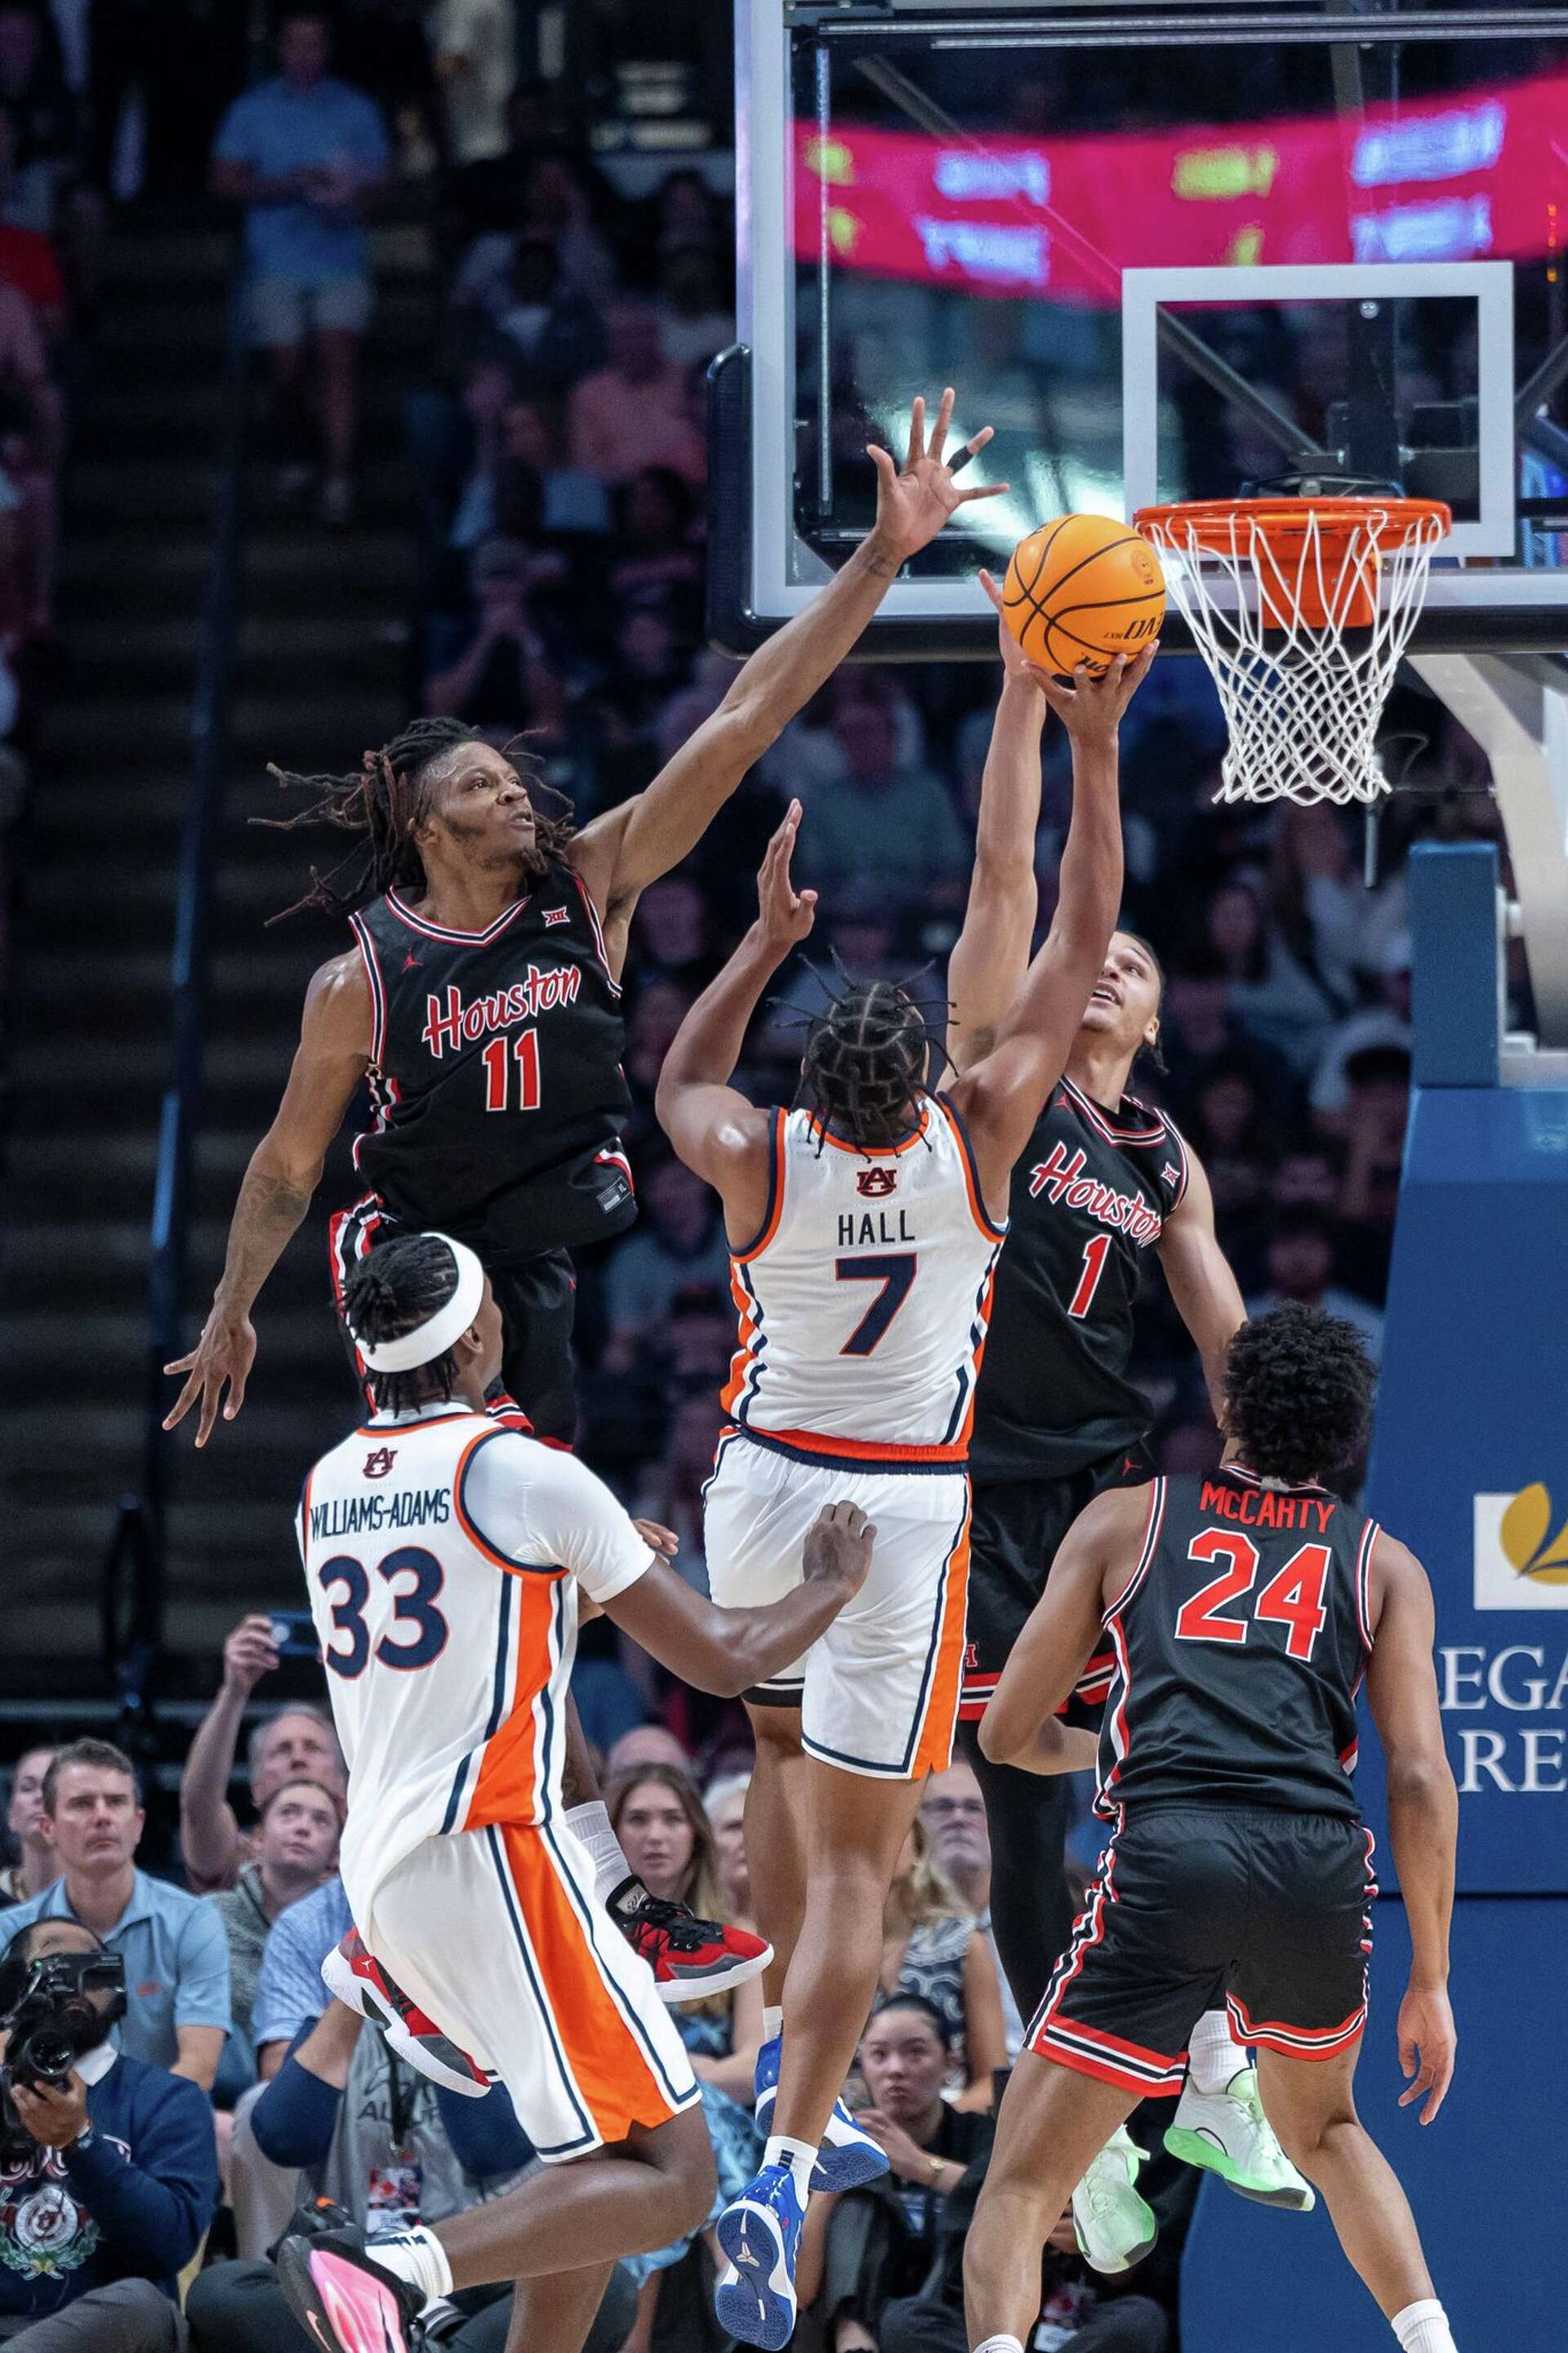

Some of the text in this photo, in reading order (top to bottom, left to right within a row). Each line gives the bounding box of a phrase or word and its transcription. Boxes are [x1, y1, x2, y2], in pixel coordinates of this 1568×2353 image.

[422, 963, 581, 1059] Houston
[482, 1027, 541, 1112] 11
[838, 1210, 915, 1246] HALL
[1029, 1140, 1163, 1249] Houston
[835, 1252, 918, 1357] 7
[1067, 1233, 1111, 1319] 1
[310, 1488, 451, 1542] WILLIAMS-ADAMS
[318, 1546, 450, 1681] 33
[1174, 1526, 1332, 1662] 24
[1439, 1645, 1568, 1711] EG
[1457, 1729, 1568, 1792] RE
